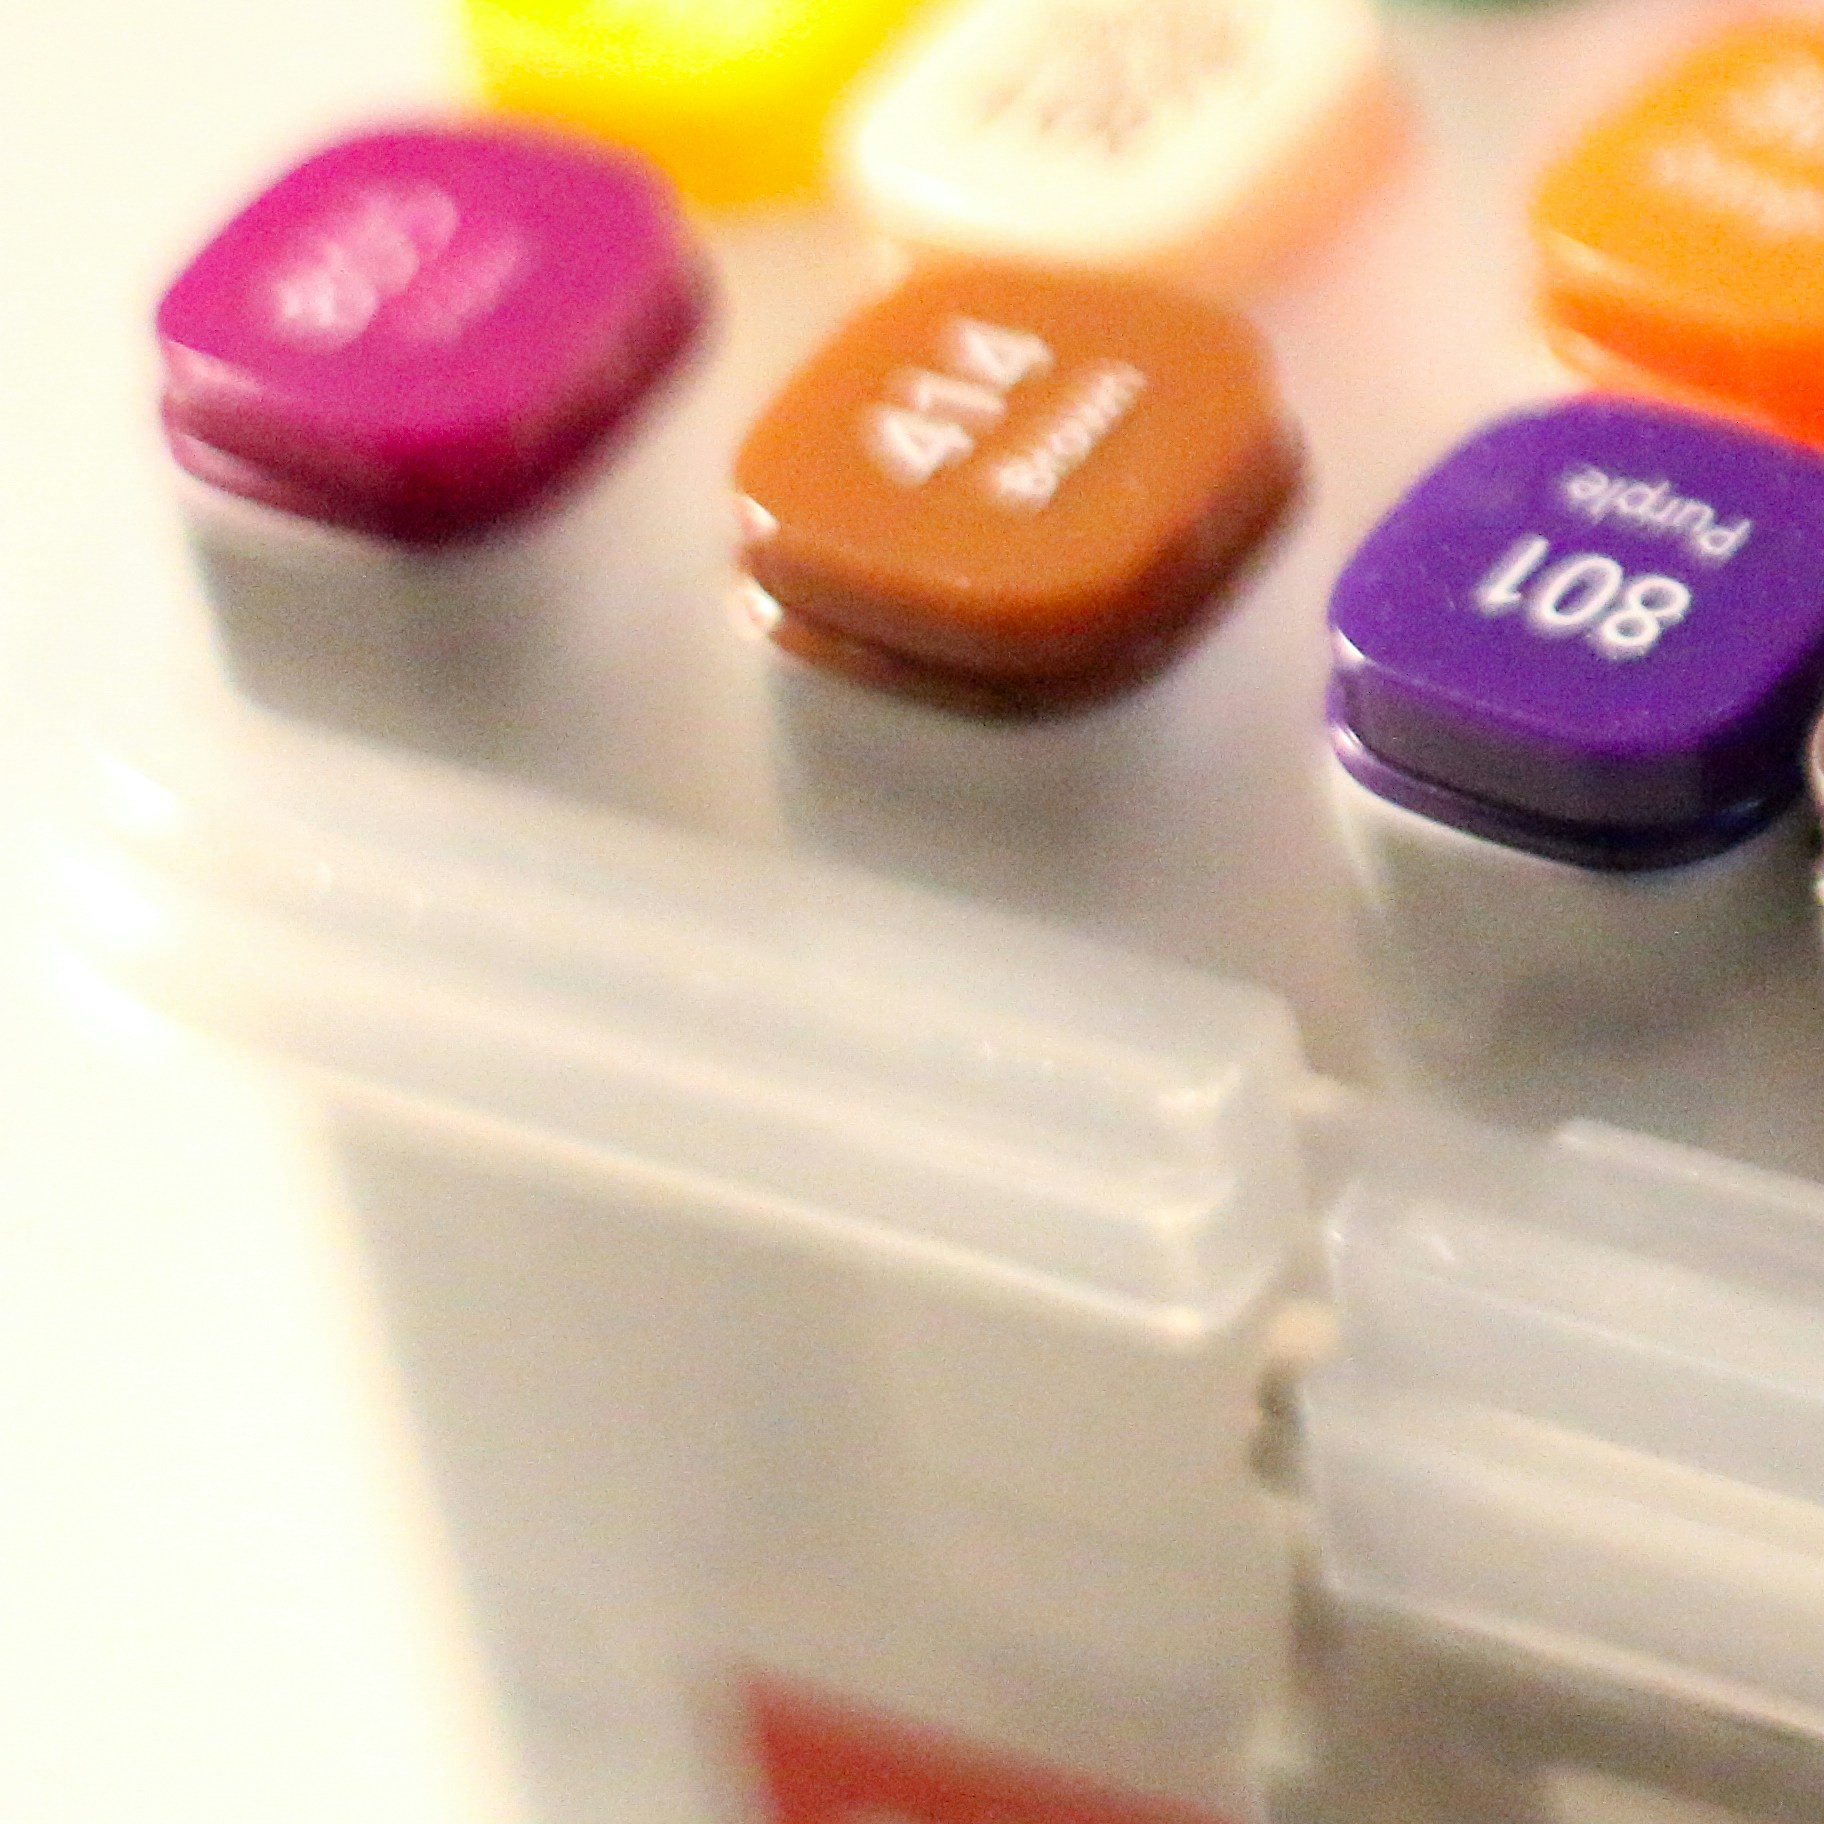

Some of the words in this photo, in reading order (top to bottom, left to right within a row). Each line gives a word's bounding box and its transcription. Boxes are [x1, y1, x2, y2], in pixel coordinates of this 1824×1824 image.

[869, 314, 1054, 488] 414
[991, 356, 1147, 514] Brown
[1562, 462, 1754, 563] Purple
[1474, 534, 1693, 661] 801
